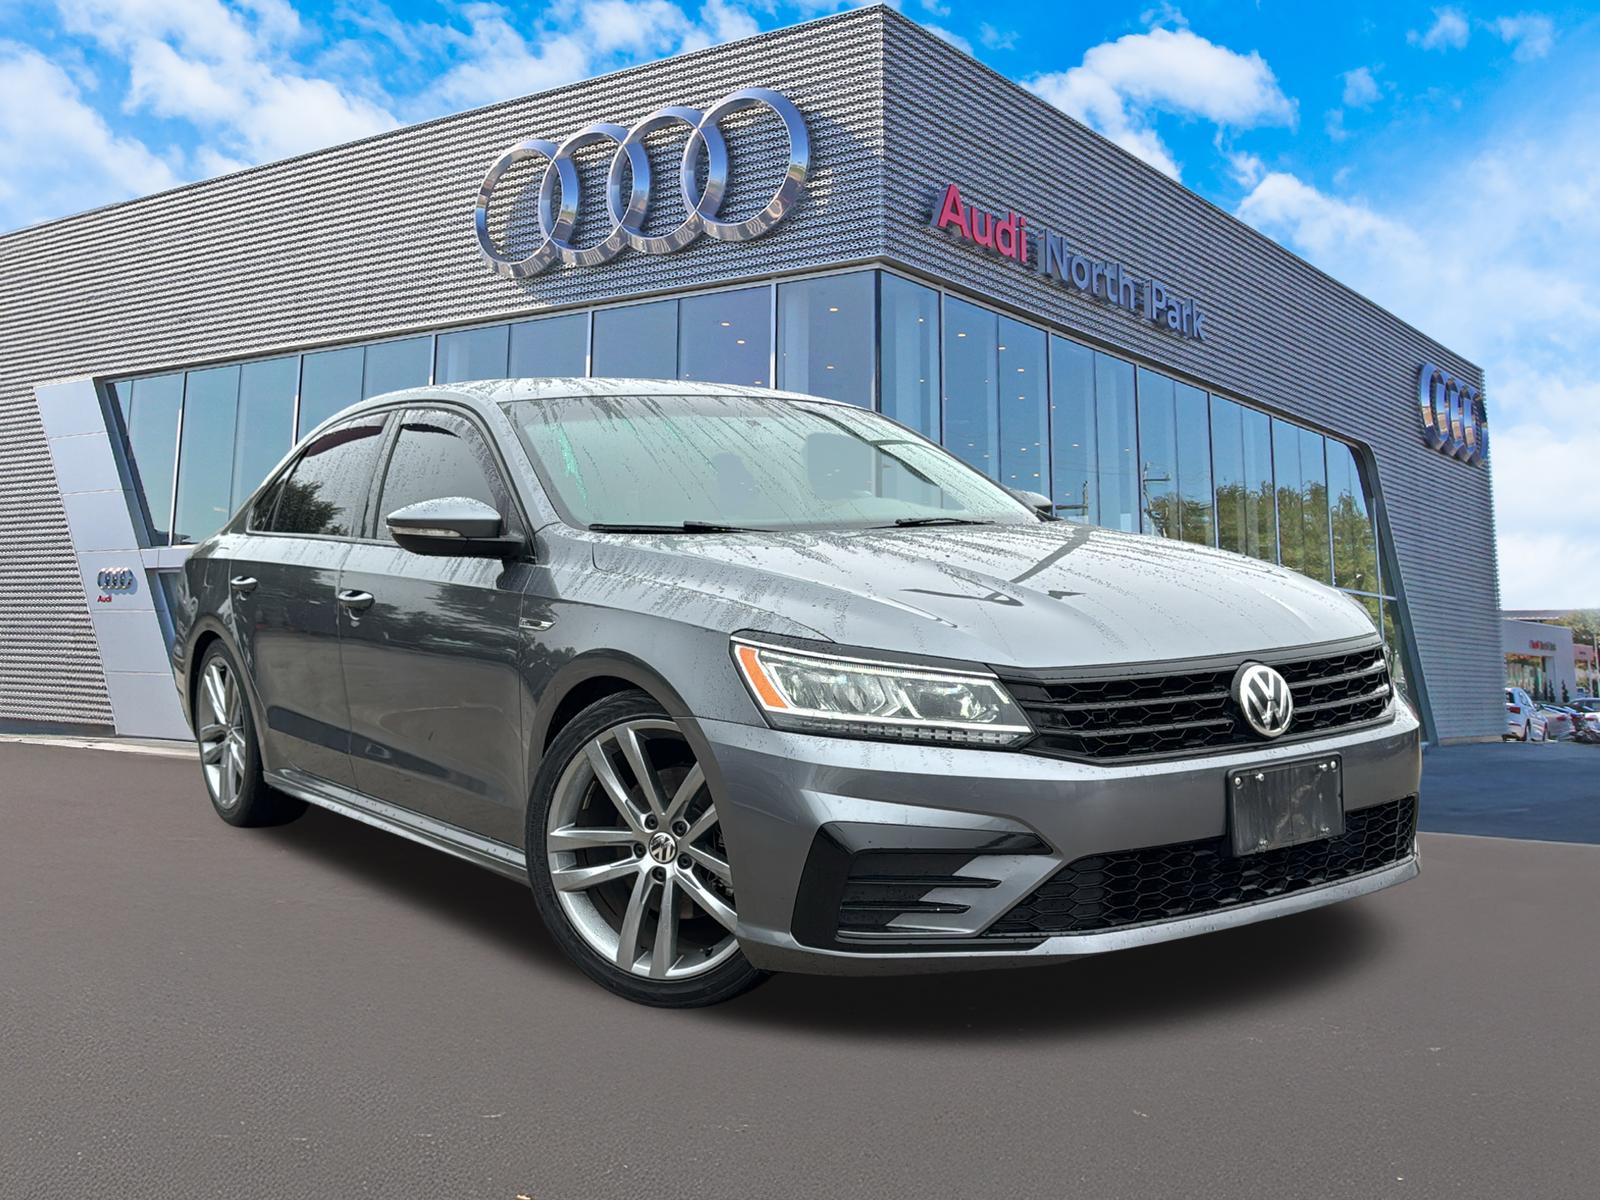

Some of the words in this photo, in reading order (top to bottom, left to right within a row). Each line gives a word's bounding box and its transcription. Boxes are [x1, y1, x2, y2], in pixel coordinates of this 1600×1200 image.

[934, 182, 1028, 263] Audi
[1041, 231, 1137, 312] North
[1148, 280, 1207, 341] Park
